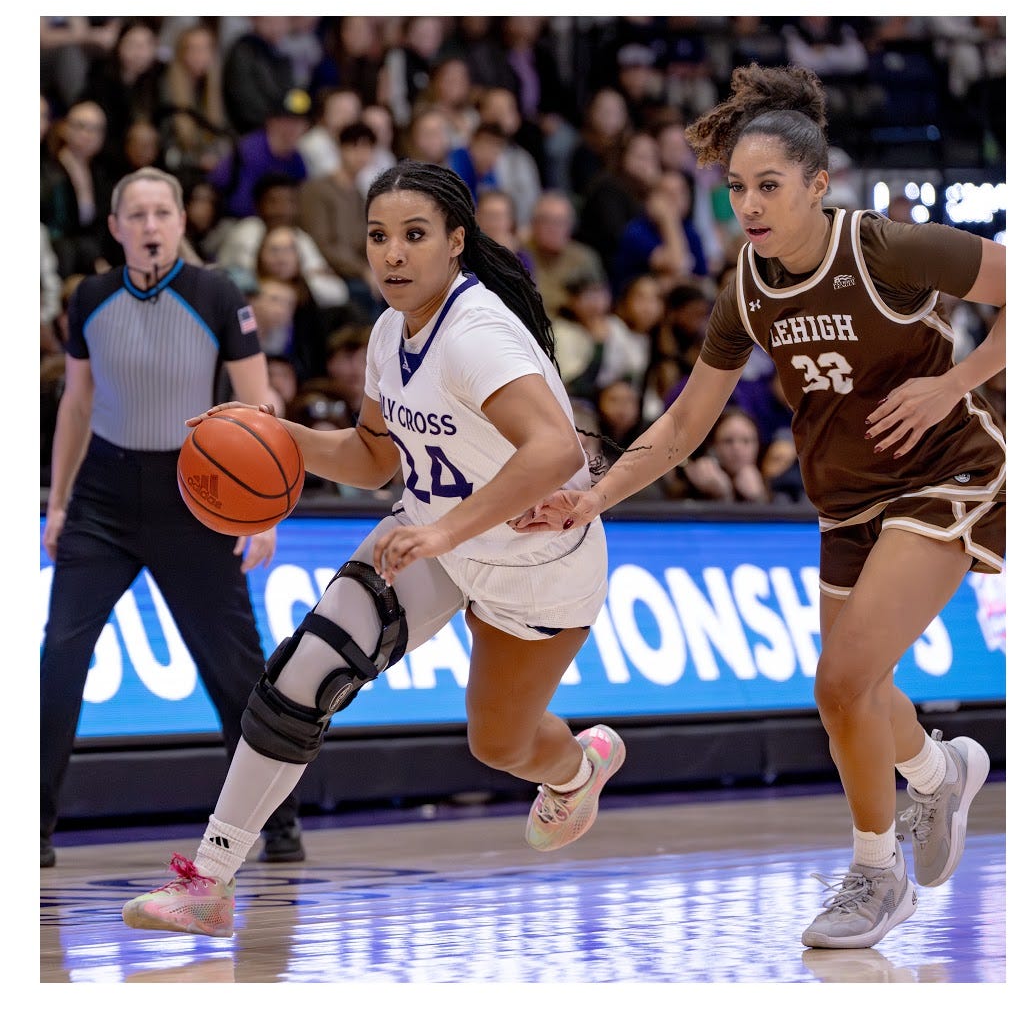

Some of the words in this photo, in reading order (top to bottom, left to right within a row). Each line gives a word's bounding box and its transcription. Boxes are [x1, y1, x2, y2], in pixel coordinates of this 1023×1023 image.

[769, 314, 859, 348] LEHIGH
[790, 351, 854, 395] 32
[397, 405, 457, 436] CROSS
[187, 476, 223, 509] adidas
